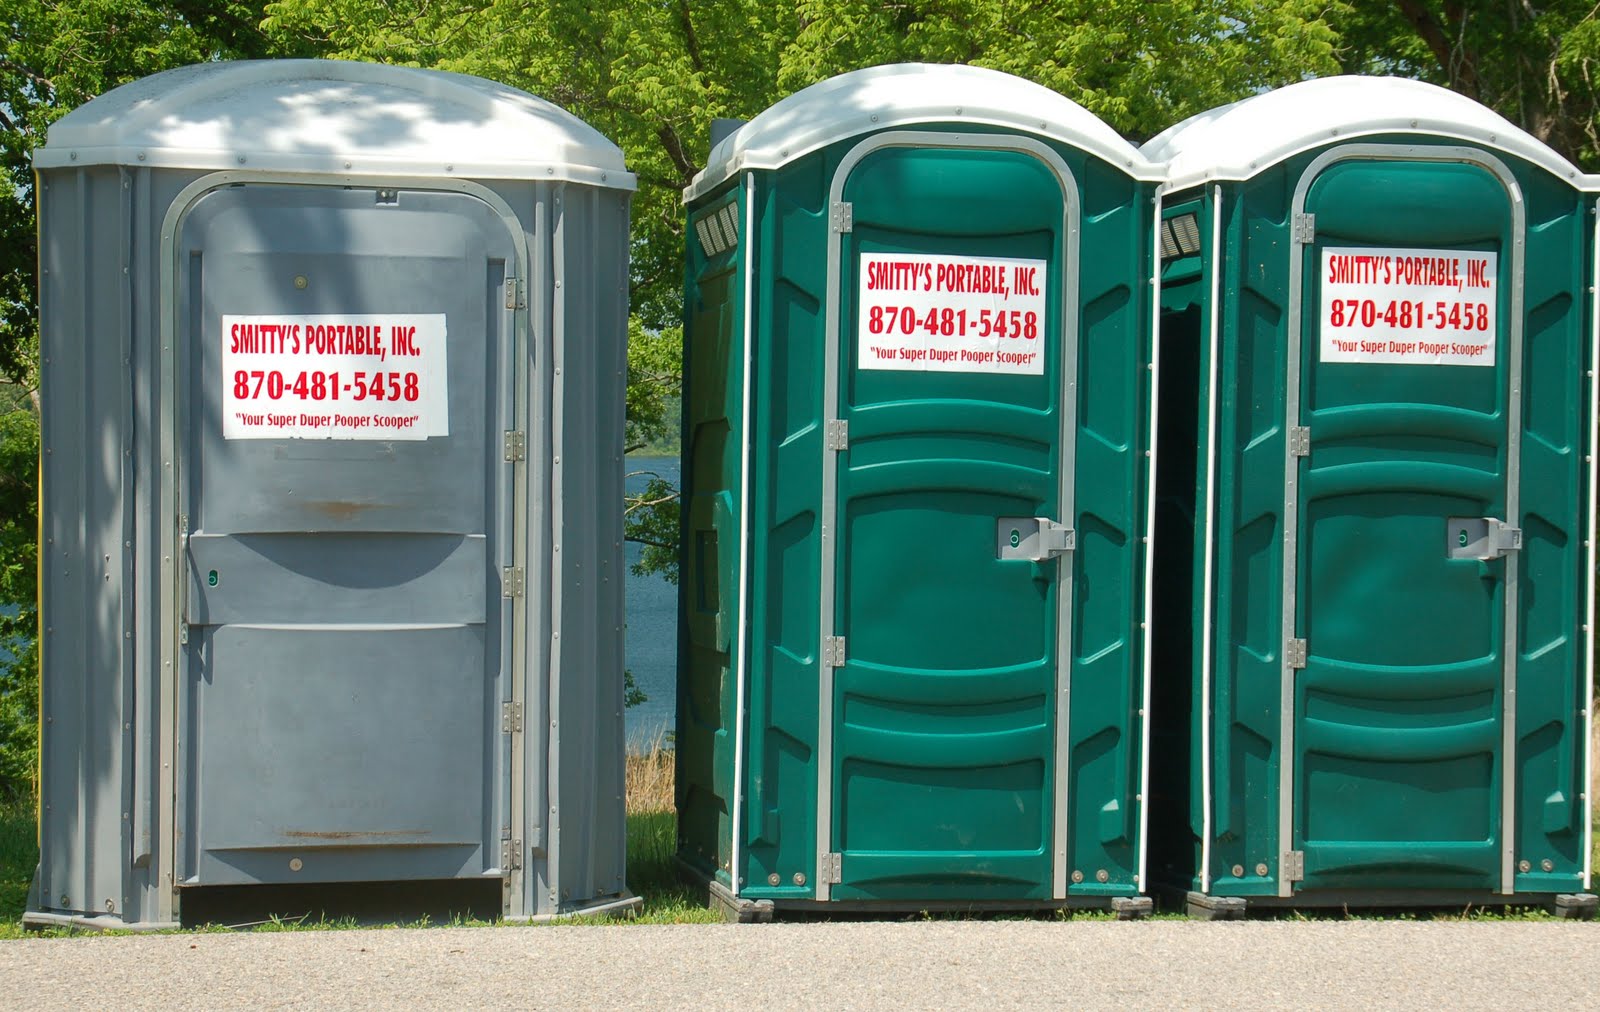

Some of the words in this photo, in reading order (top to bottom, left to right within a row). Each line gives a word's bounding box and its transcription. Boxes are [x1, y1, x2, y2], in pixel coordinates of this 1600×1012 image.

[868, 261, 932, 291] SMITTY'S
[937, 264, 1009, 300] PORTABLE,
[1014, 267, 1039, 296] INC.
[1329, 255, 1391, 284] SMITTY'S
[1396, 257, 1463, 292] PORTABLE,
[1467, 260, 1489, 288] INC.
[869, 306, 1037, 339] 870-481-5458
[1331, 299, 1488, 331] 870-481-5458
[231, 324, 299, 354] SMITTY'S
[306, 325, 386, 362] PORTABLE,
[392, 326, 420, 356] INC.
[900, 348, 926, 362] Super
[930, 349, 957, 362] Duper
[961, 350, 993, 364] Pooper
[1361, 340, 1386, 355] Super
[1390, 341, 1415, 355] Duper
[1419, 342, 1449, 356] Pooper
[234, 370, 419, 401] 870-481-5458
[267, 414, 296, 428] Super
[300, 414, 331, 428] Duper
[335, 415, 370, 429] Pooper
